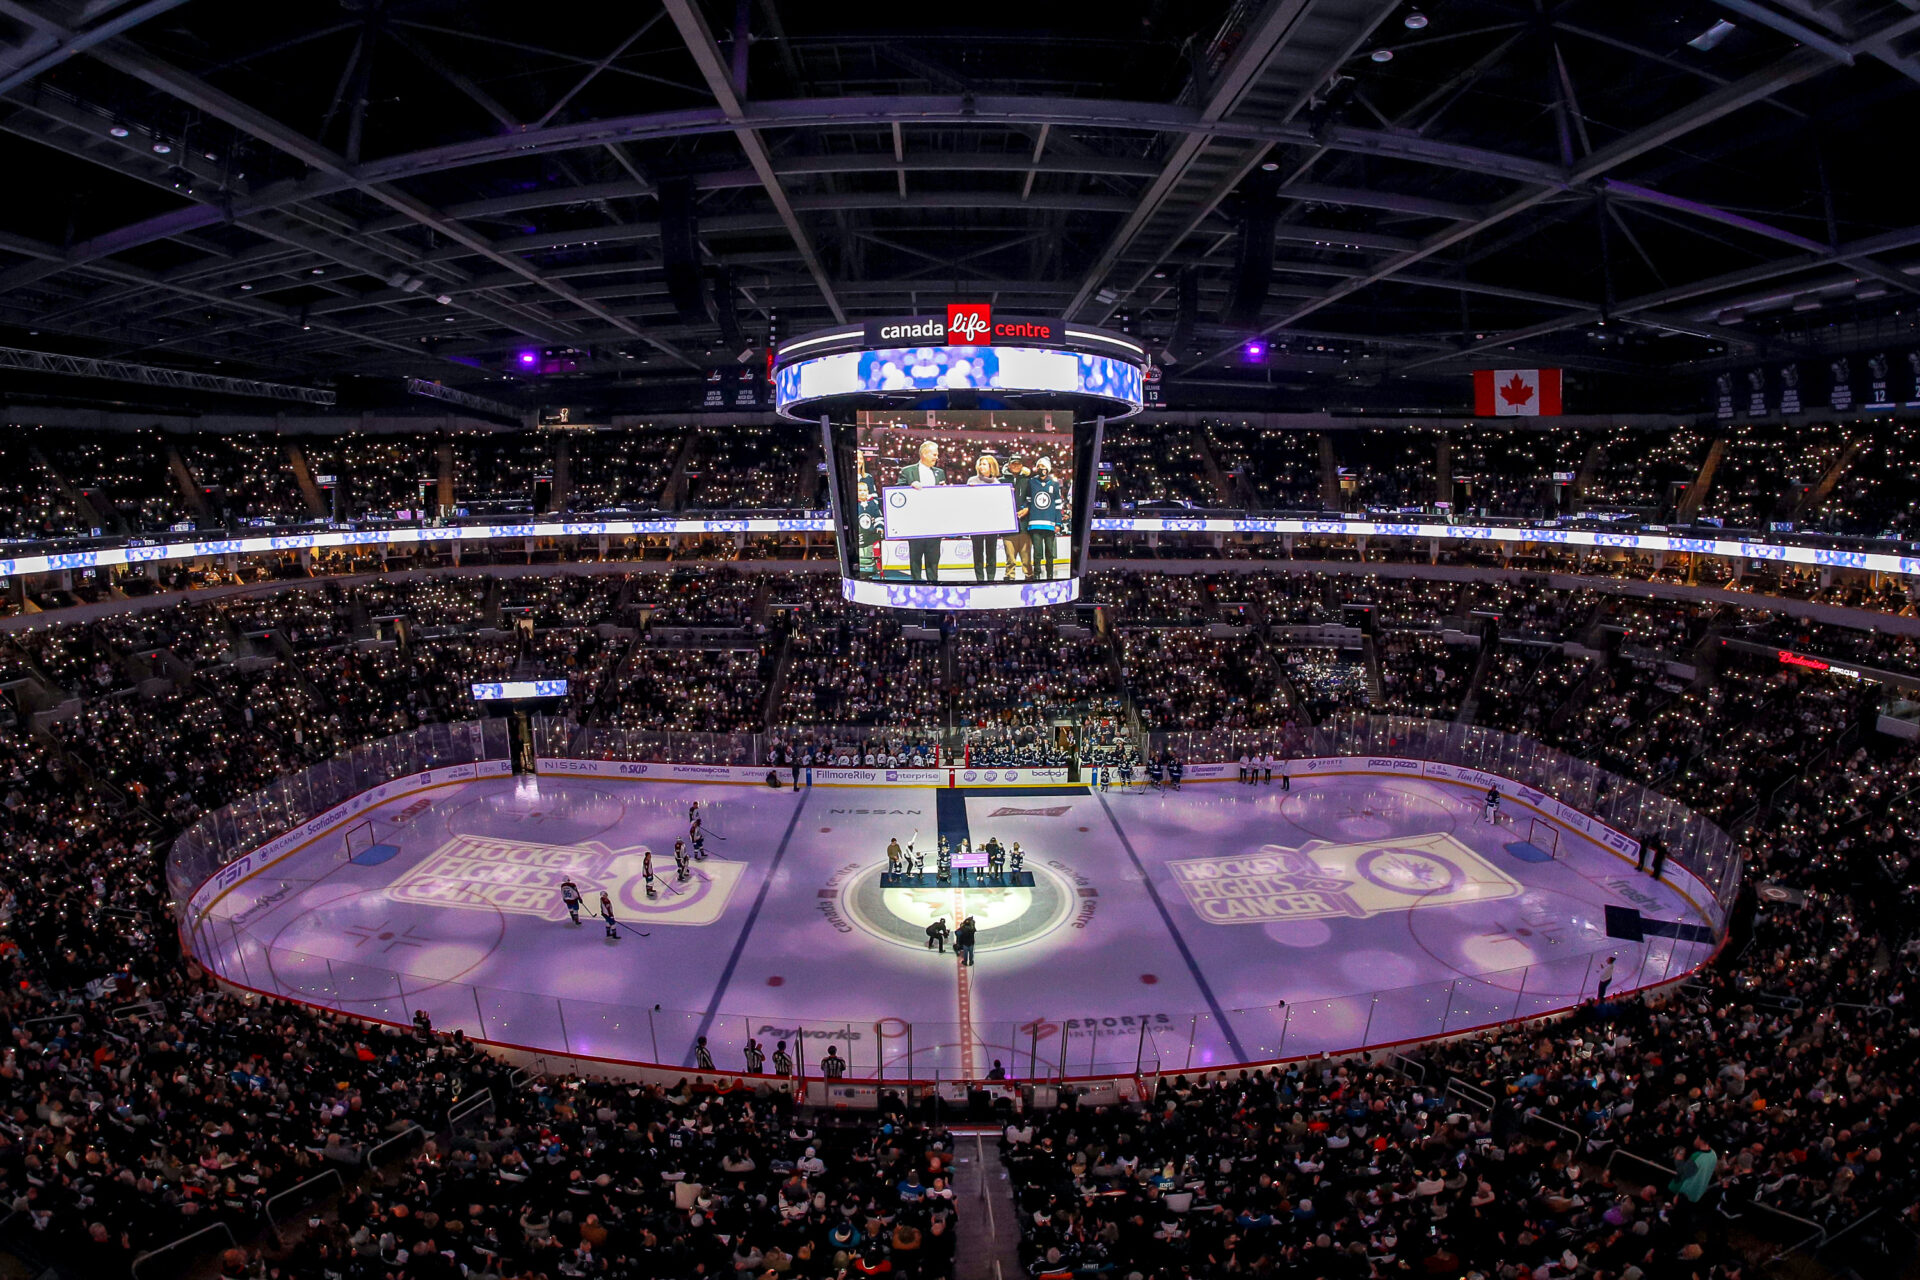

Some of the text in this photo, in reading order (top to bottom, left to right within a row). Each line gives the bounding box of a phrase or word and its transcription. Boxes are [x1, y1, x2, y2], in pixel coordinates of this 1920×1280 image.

[880, 313, 1050, 342] canada life centre
[1149, 391, 1158, 400] 13
[1874, 390, 1886, 402] 12
[1778, 650, 1829, 670] Budweiser
[544, 761, 598, 771] NISSAN
[628, 764, 648, 774] SKIP
[888, 771, 939, 780] enterprise
[1368, 759, 1417, 769] pizza pizza
[1457, 768, 1472, 782] Tim
[1473, 772, 1504, 792] Hortons
[307, 807, 348, 835] Scotiabank
[269, 832, 304, 856] AIR CANADA
[1603, 828, 1640, 857] TSN
[454, 841, 591, 868] HOCKEY
[215, 857, 251, 890] TSN
[434, 859, 557, 886] FIGHTS
[1179, 857, 1289, 880] HOCKEY
[407, 878, 557, 910] CANCER
[1193, 875, 1297, 898] FIGHTS
[1203, 893, 1334, 919] CANCER
[1067, 1013, 1170, 1029] SPORTS
[757, 1025, 861, 1041] Payworks
